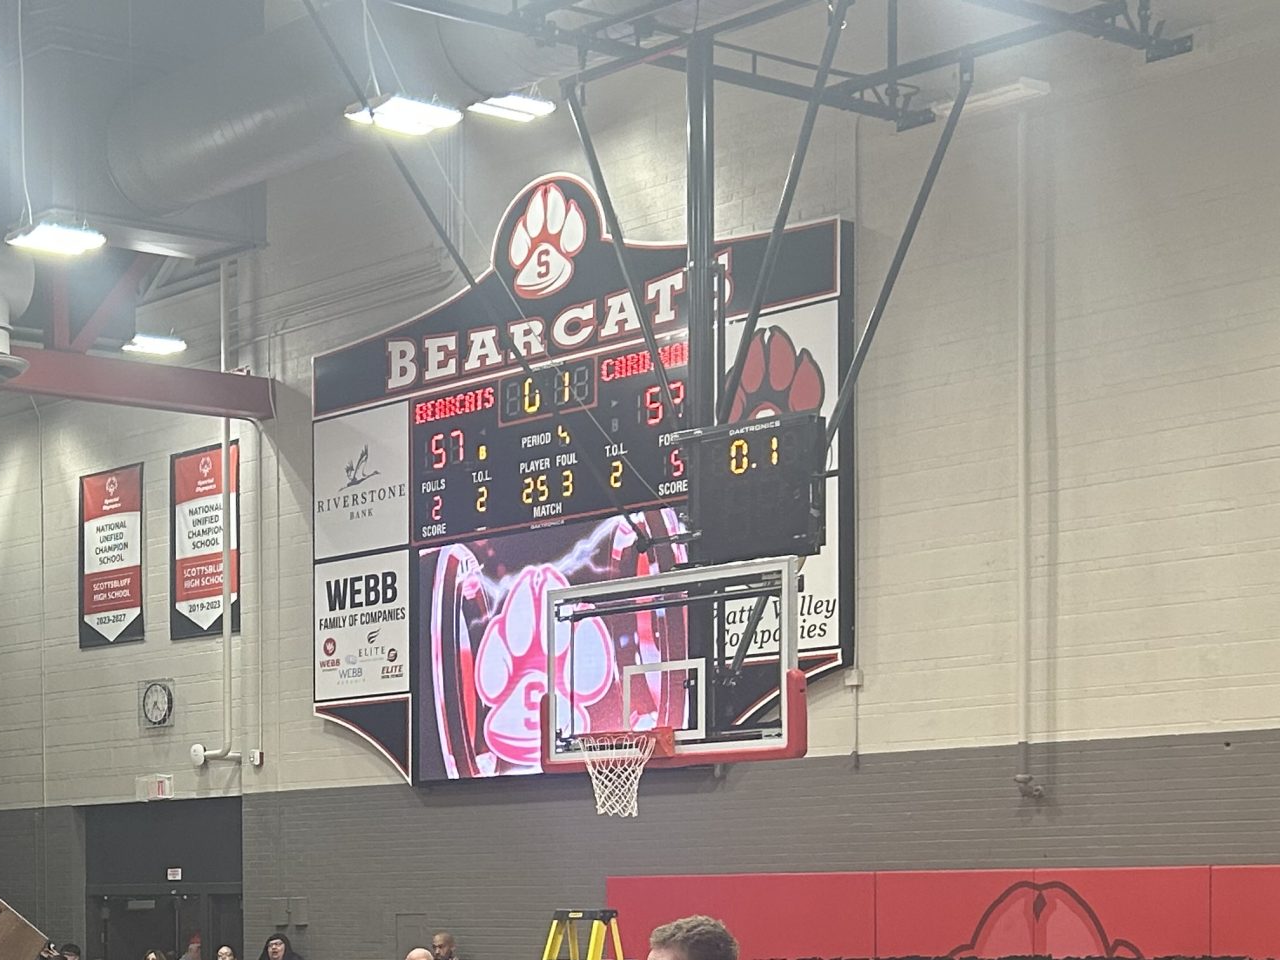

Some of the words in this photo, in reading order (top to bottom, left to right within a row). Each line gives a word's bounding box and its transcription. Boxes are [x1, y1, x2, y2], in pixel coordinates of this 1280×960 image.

[536, 248, 551, 278] S
[415, 386, 495, 424] BEARCATS
[521, 432, 551, 448] PERIOD
[558, 425, 570, 444] 4
[431, 430, 464, 469] 57
[730, 437, 779, 474] 0.1
[520, 458, 550, 474] PLAYER
[556, 453, 578, 468] FOUL
[610, 460, 623, 488] 2
[422, 478, 446, 494] FOULS
[522, 475, 549, 504] 25
[562, 470, 573, 497] 3
[658, 478, 688, 497] SCORE
[317, 483, 406, 513] RIVERSTONE
[476, 486, 488, 512] 2
[349, 508, 373, 520] BANK
[432, 495, 443, 521] 2
[533, 503, 562, 519] MATCH
[96, 520, 127, 534] NATIONAL
[192, 514, 219, 528] UNIFIED
[100, 531, 124, 543] UNIFIED
[422, 523, 446, 538] SCORE
[95, 542, 129, 555] CHAMPION
[192, 537, 220, 550] SCHOOL
[99, 553, 124, 565] SCHOOL
[183, 579, 200, 588] HIGH
[201, 574, 223, 586] SCHOO
[107, 590, 131, 600] SCHOOL
[325, 571, 398, 612] WEBB
[188, 600, 221, 613] 2019-2023
[772, 594, 837, 620] Vlley
[319, 616, 347, 631] FAMILY
[349, 613, 359, 627] OF
[360, 607, 406, 625] COMPANIES
[358, 646, 386, 658] ELITE
[319, 658, 341, 668] WEBB
[381, 664, 404, 675] ELITE
[338, 667, 363, 679] WEBB
